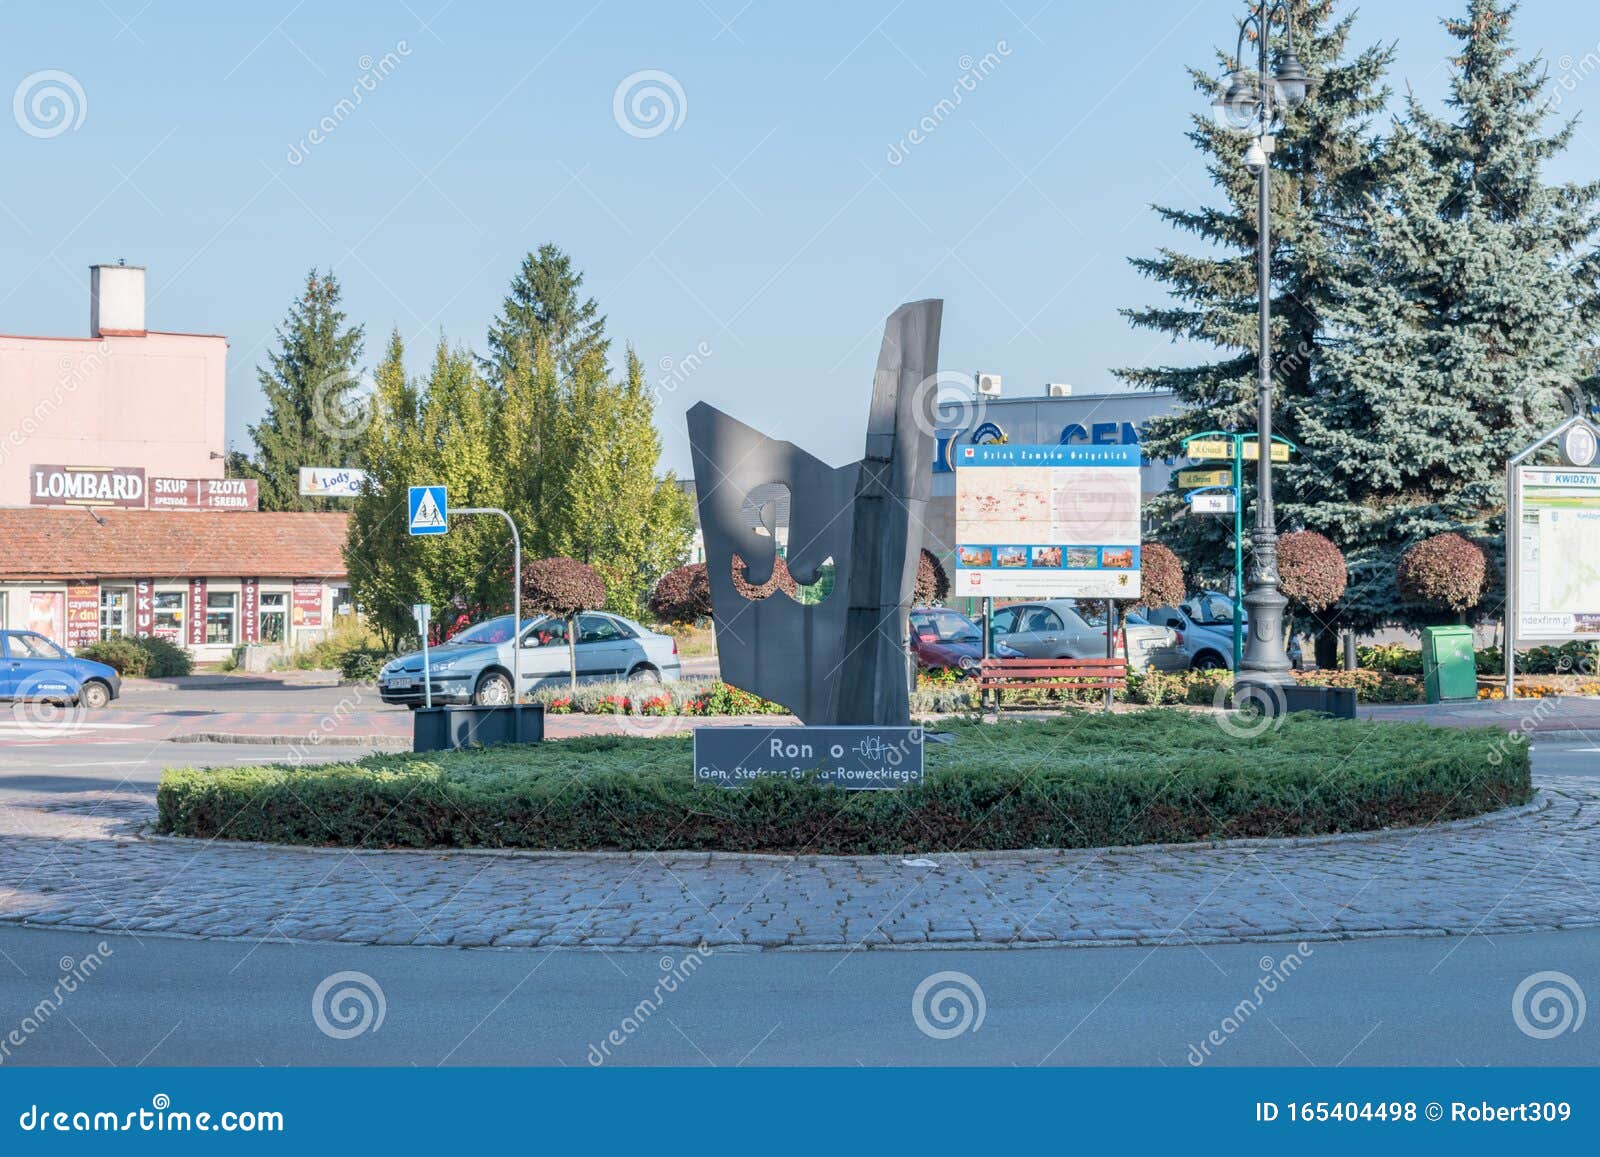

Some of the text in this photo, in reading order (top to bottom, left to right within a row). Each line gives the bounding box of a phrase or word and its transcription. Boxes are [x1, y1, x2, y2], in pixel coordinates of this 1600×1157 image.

[35, 471, 143, 499] LOMBARD
[322, 472, 350, 489] Lody
[1555, 474, 1597, 484] KWIDZYN
[155, 479, 188, 494] SKUP
[208, 480, 247, 495] ZŁOTA
[214, 495, 249, 507] SREBRA
[69, 609, 98, 621] 7 dni
[699, 767, 731, 779] Gen.
